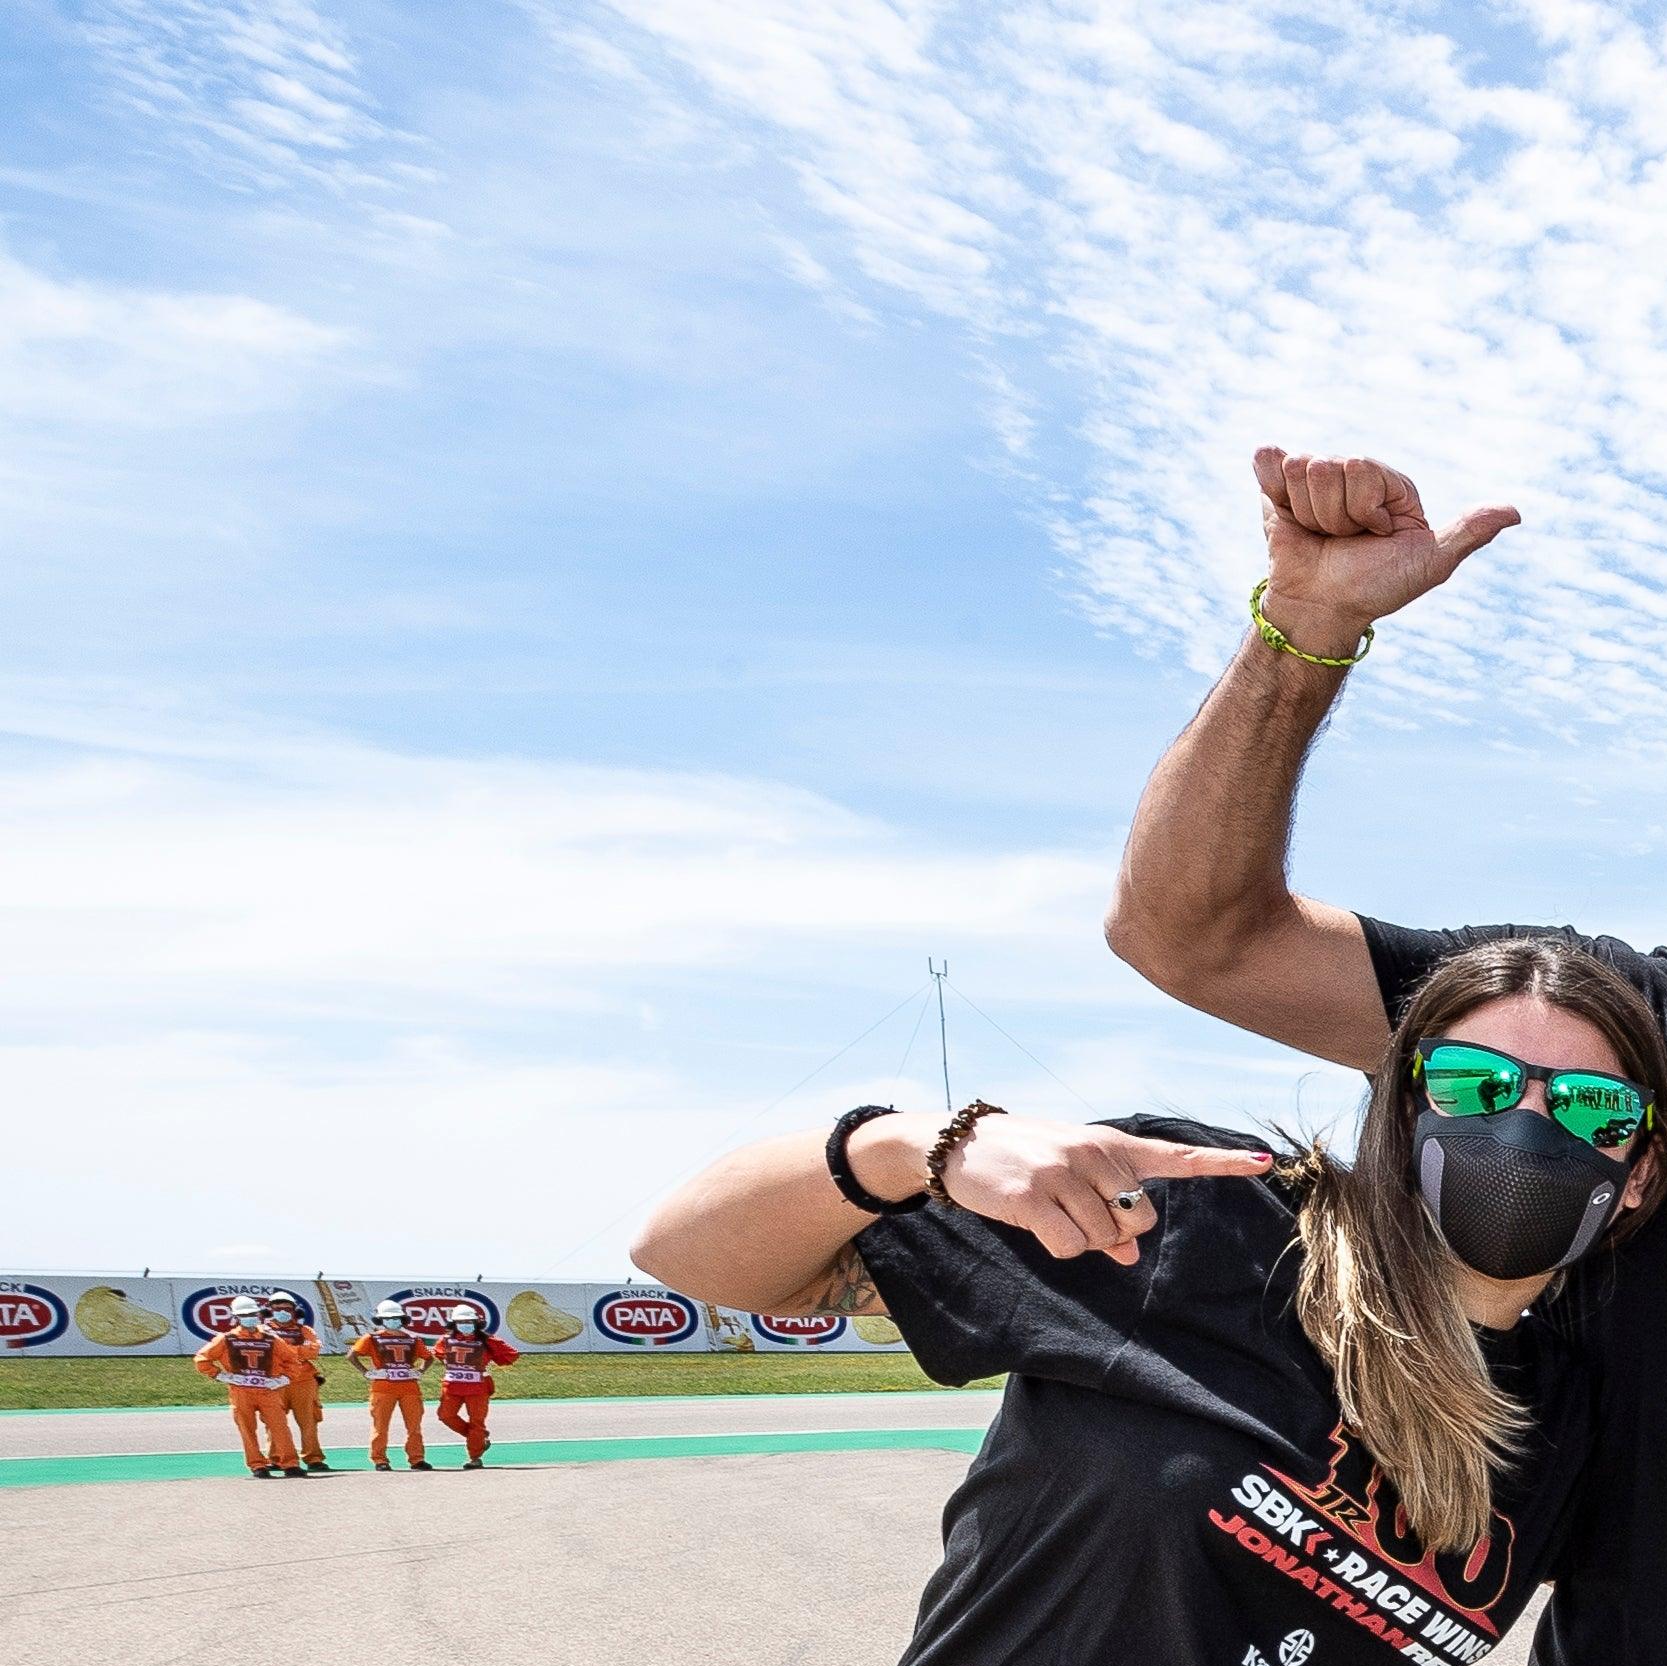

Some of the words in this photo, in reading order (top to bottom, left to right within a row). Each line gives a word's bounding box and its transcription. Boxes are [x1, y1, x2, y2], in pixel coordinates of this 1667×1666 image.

[218, 1286, 272, 1295] SNACK
[413, 1287, 465, 1297] SNACK
[622, 1289, 665, 1299] SNACK
[614, 1307, 677, 1327] PATA
[1230, 1473, 1316, 1548] SBK
[1332, 1550, 1425, 1627] RACE
[1419, 1610, 1494, 1666] WINS
